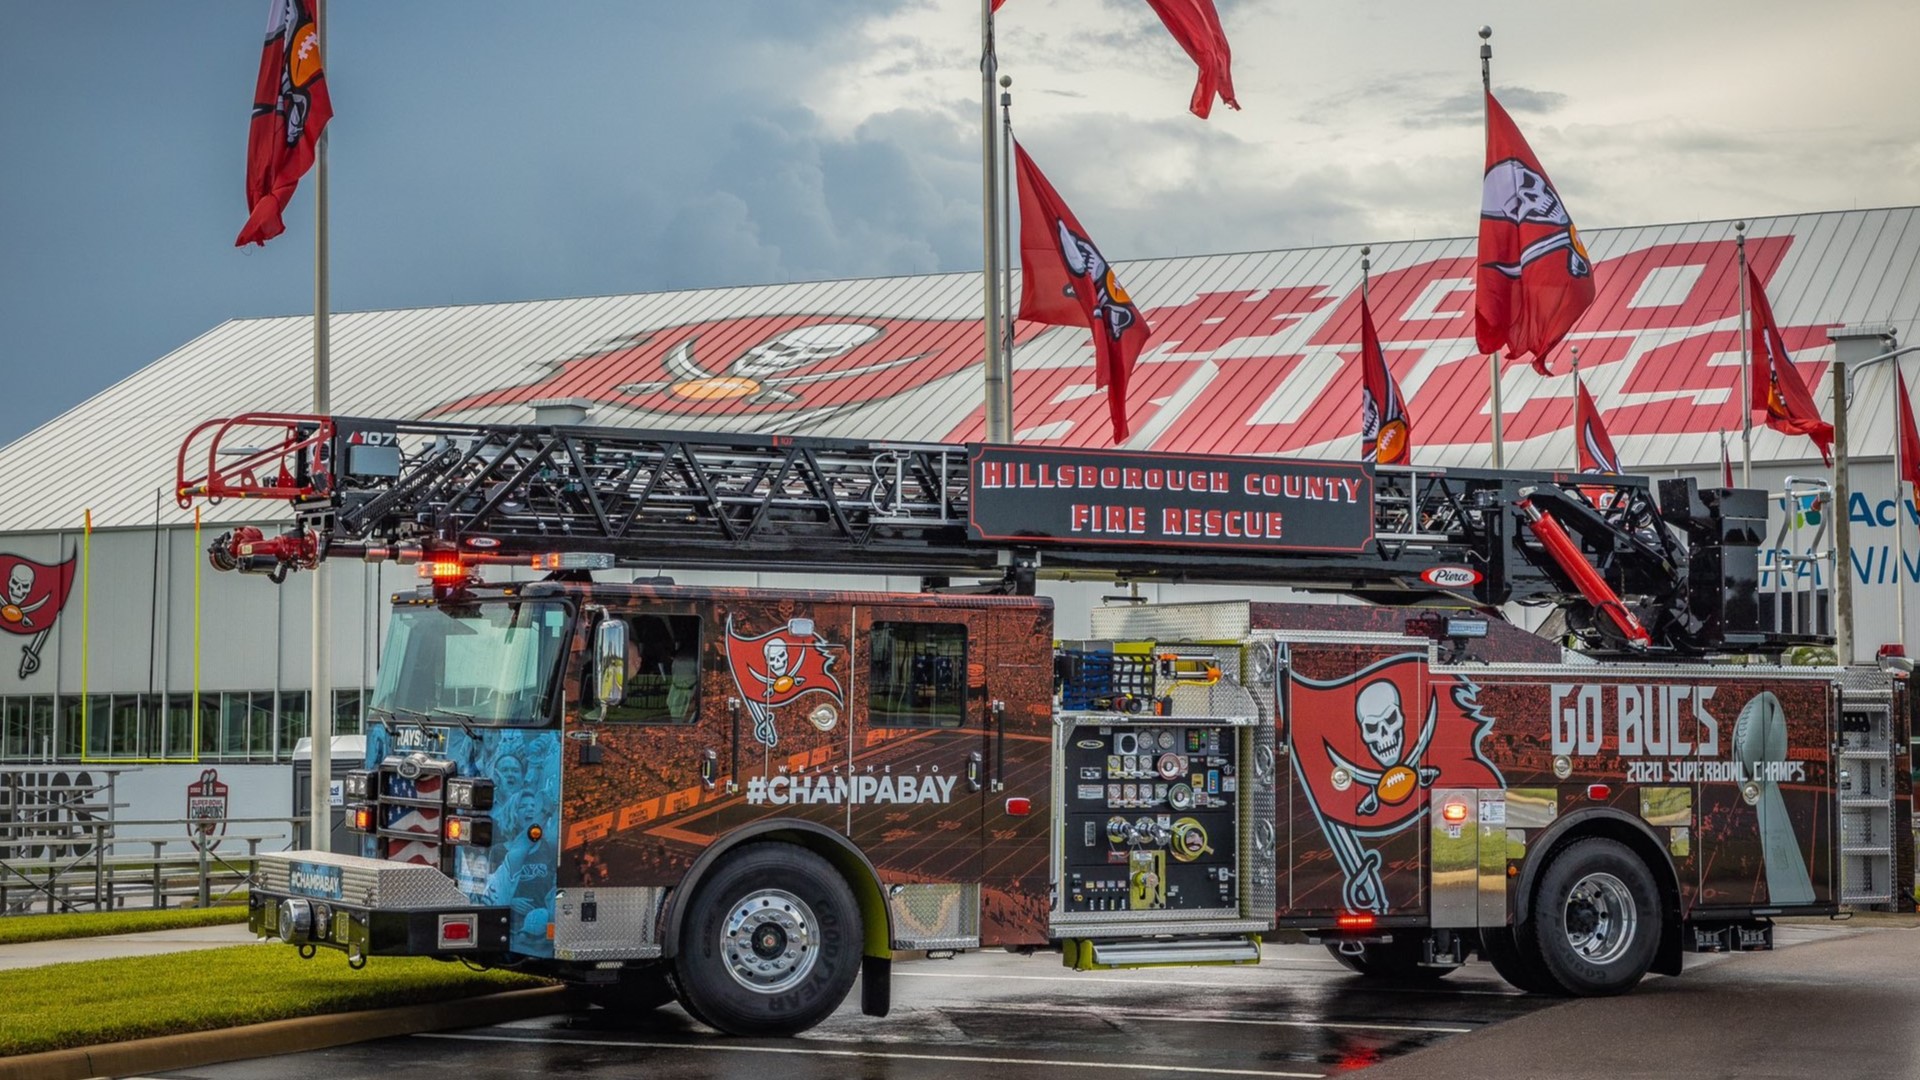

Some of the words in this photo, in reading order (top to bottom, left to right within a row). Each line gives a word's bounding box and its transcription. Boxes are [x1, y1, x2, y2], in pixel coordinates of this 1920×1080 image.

[360, 431, 395, 445] 107
[981, 462, 1230, 493] HILLSBOROUGH
[1244, 473, 1363, 503] COUNTY
[1071, 504, 1146, 532] FIRE
[1162, 508, 1282, 538] RESCUE
[1435, 569, 1469, 583] Pierce
[1551, 685, 1603, 755] GO
[1618, 685, 1718, 756] BUCS
[778, 765, 891, 773] WELCOME
[915, 765, 939, 773] TO
[1627, 761, 1663, 782] 2020
[1668, 761, 1748, 782] SUPERBOWL
[1753, 761, 1806, 782] CHAMPS
[747, 775, 958, 805] #CHAMPABAY
[292, 870, 339, 893] #CHAMPABAY
